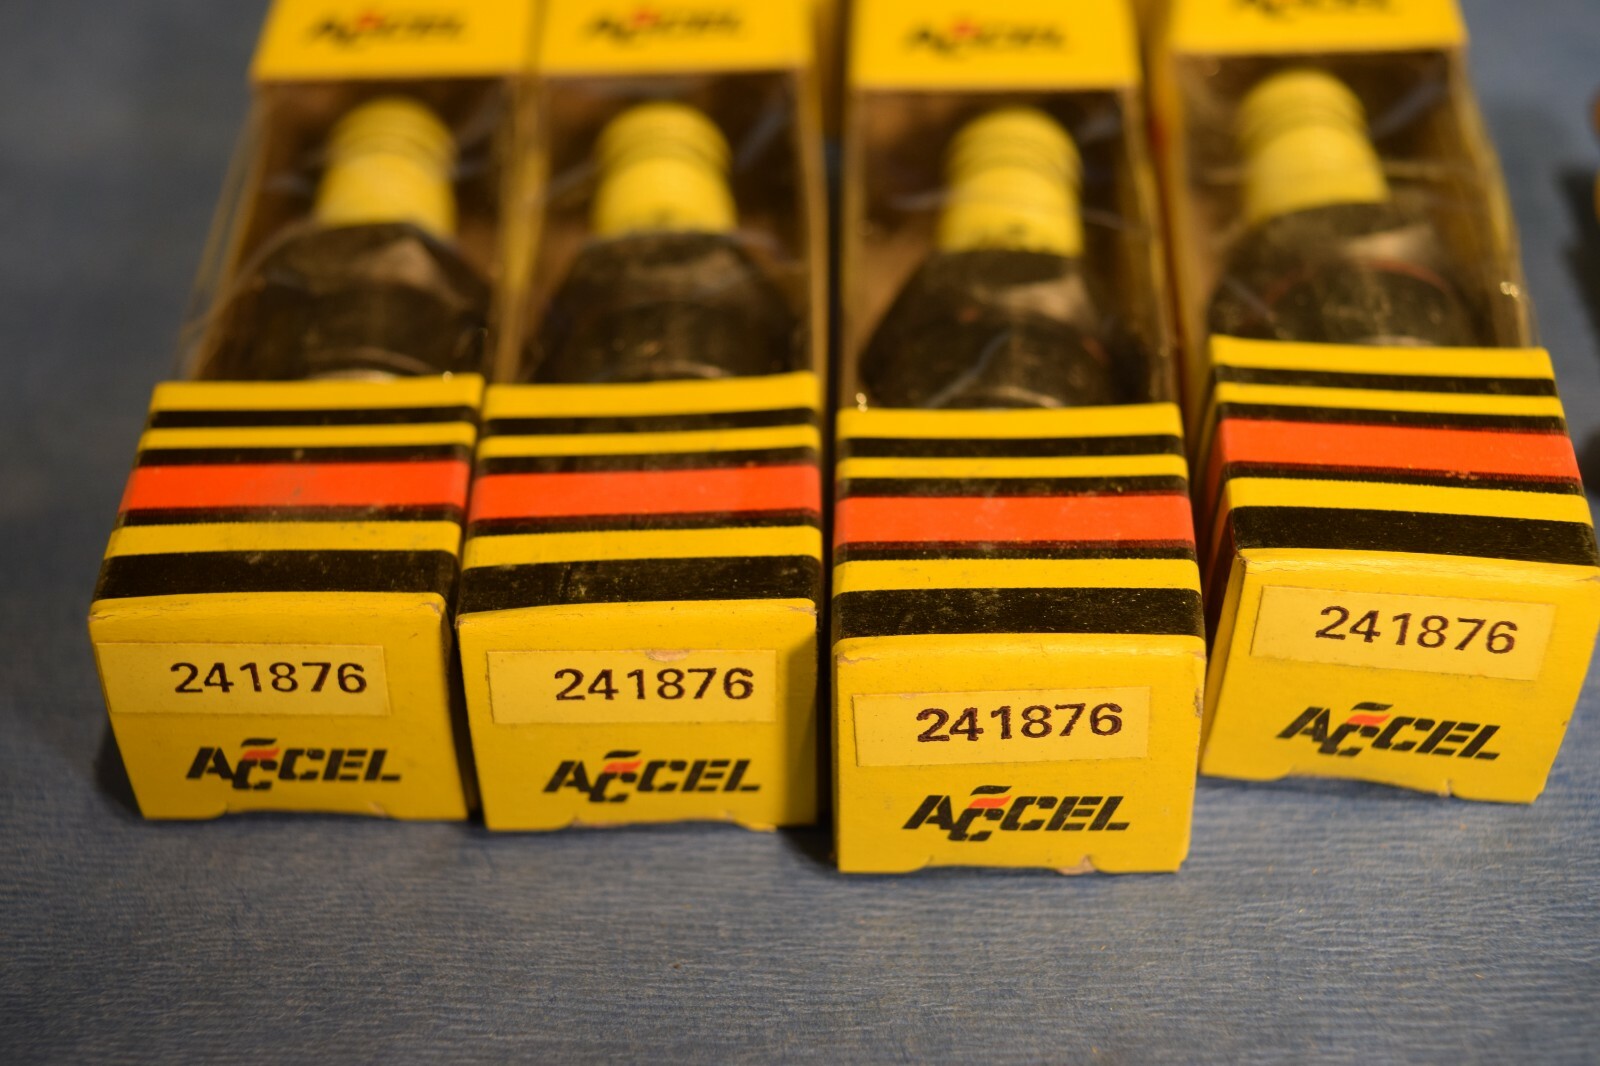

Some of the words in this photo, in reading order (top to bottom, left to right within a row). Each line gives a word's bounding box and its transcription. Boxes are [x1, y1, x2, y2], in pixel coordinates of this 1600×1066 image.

[1315, 605, 1518, 655] 241876
[169, 661, 367, 694] 241876
[554, 667, 754, 701] 241876
[915, 702, 1123, 743] 241876
[1277, 702, 1501, 760] ACCEL
[185, 737, 402, 791] ACCEL
[543, 750, 760, 804] ACCEL
[902, 785, 1130, 842] ACCEL
